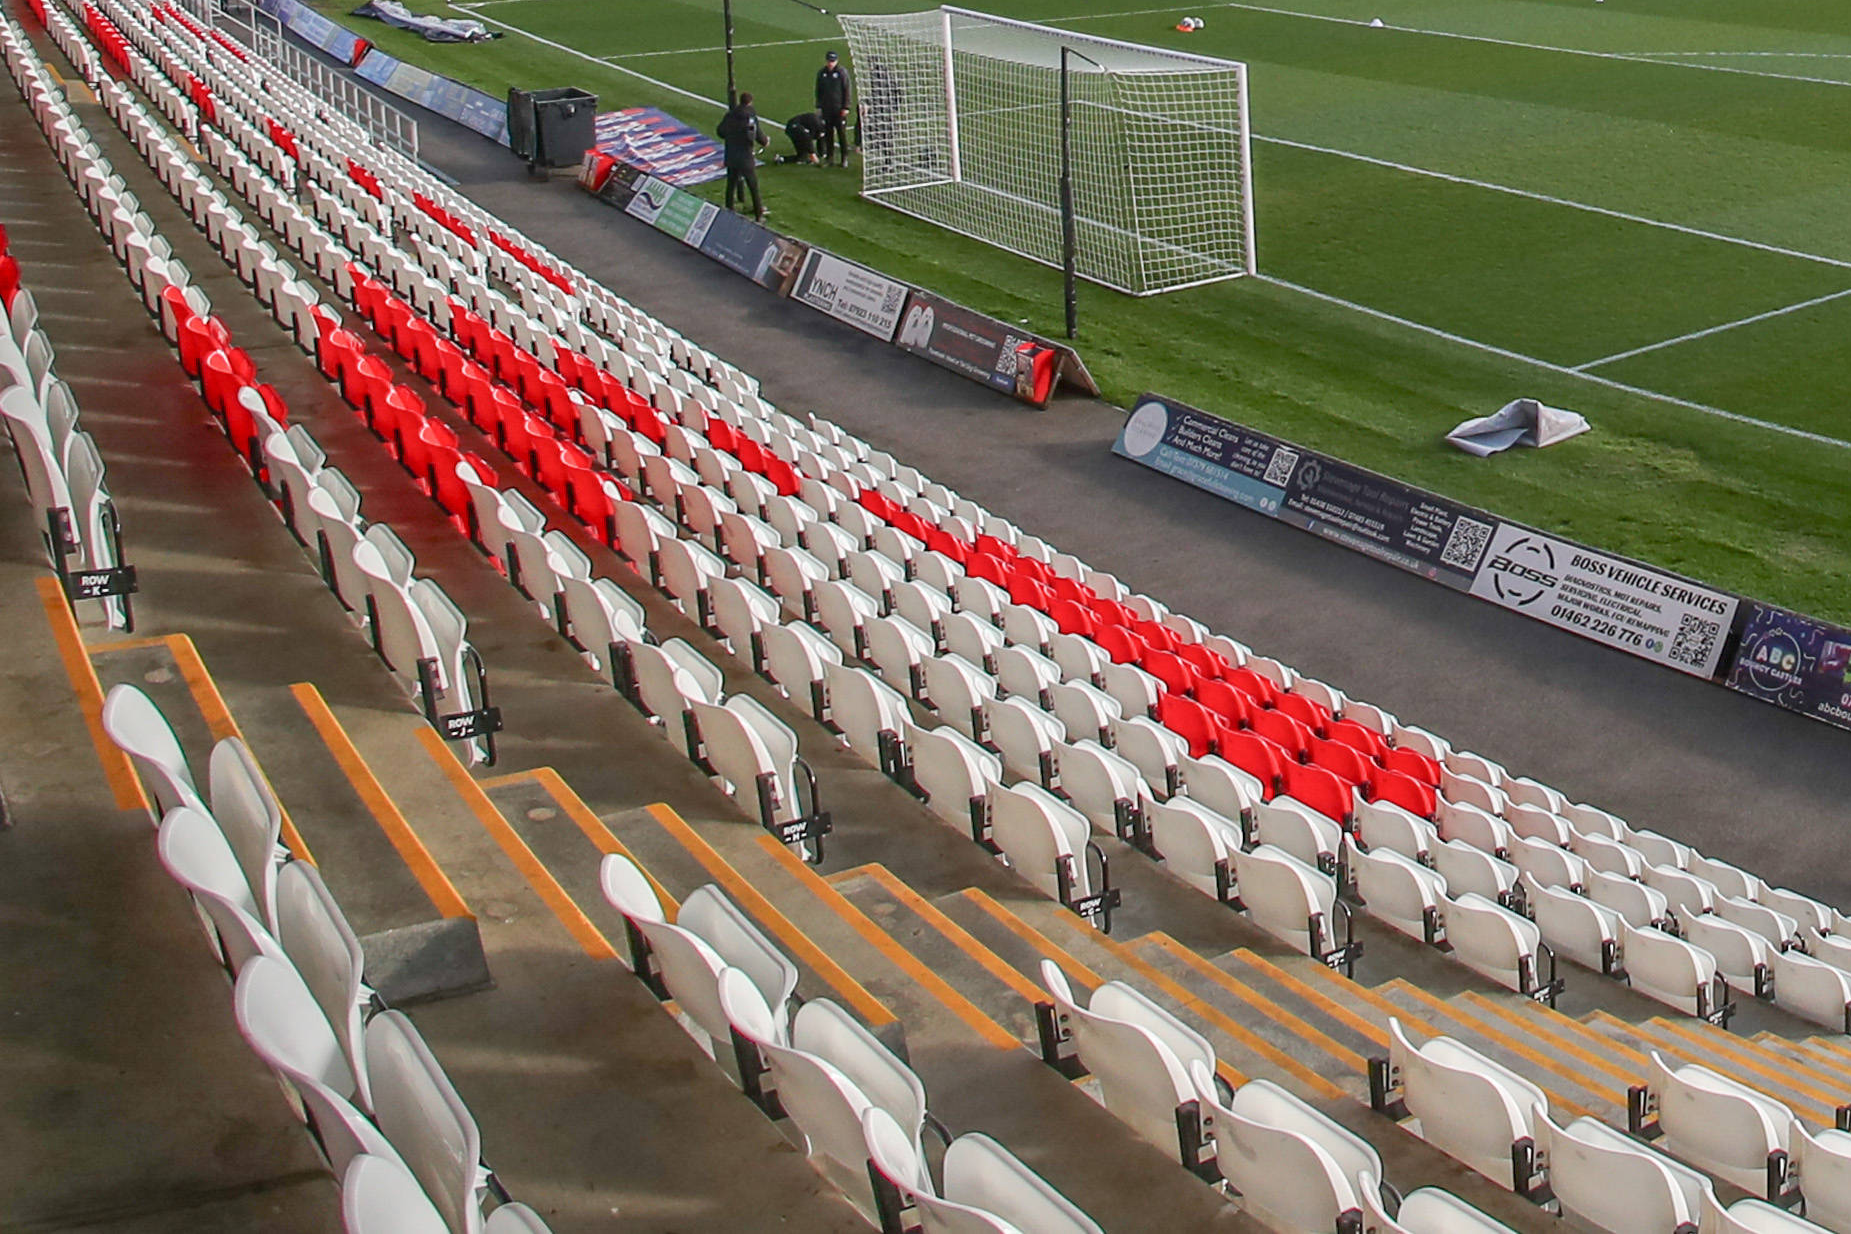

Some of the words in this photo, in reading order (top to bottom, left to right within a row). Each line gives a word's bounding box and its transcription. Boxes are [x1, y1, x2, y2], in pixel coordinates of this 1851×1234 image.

[1178, 425, 1201, 441] Builders
[1202, 434, 1222, 450] Cleans
[1183, 416, 1219, 436] Commercial
[1218, 428, 1239, 444] Cleans
[1172, 435, 1186, 447] And
[1186, 440, 1202, 454] Much
[1203, 446, 1222, 462] More!
[81, 574, 110, 586] ROW
[1487, 554, 1559, 589] BOSS
[1570, 554, 1607, 577] BOSS
[1607, 564, 1663, 595] VEHICLE
[1659, 580, 1729, 616] SERVICES
[1551, 604, 1590, 631] 01462
[1590, 617, 1618, 639] 226
[1617, 627, 1642, 647] 776
[1557, 592, 1582, 609] MAJOR
[1626, 614, 1671, 639] REMAPPING
[1739, 656, 1771, 676] BOUNCY
[1770, 668, 1802, 685] CASTLES
[1755, 645, 1795, 671] ABC
[448, 715, 475, 730] ROW
[783, 820, 808, 837] ROW
